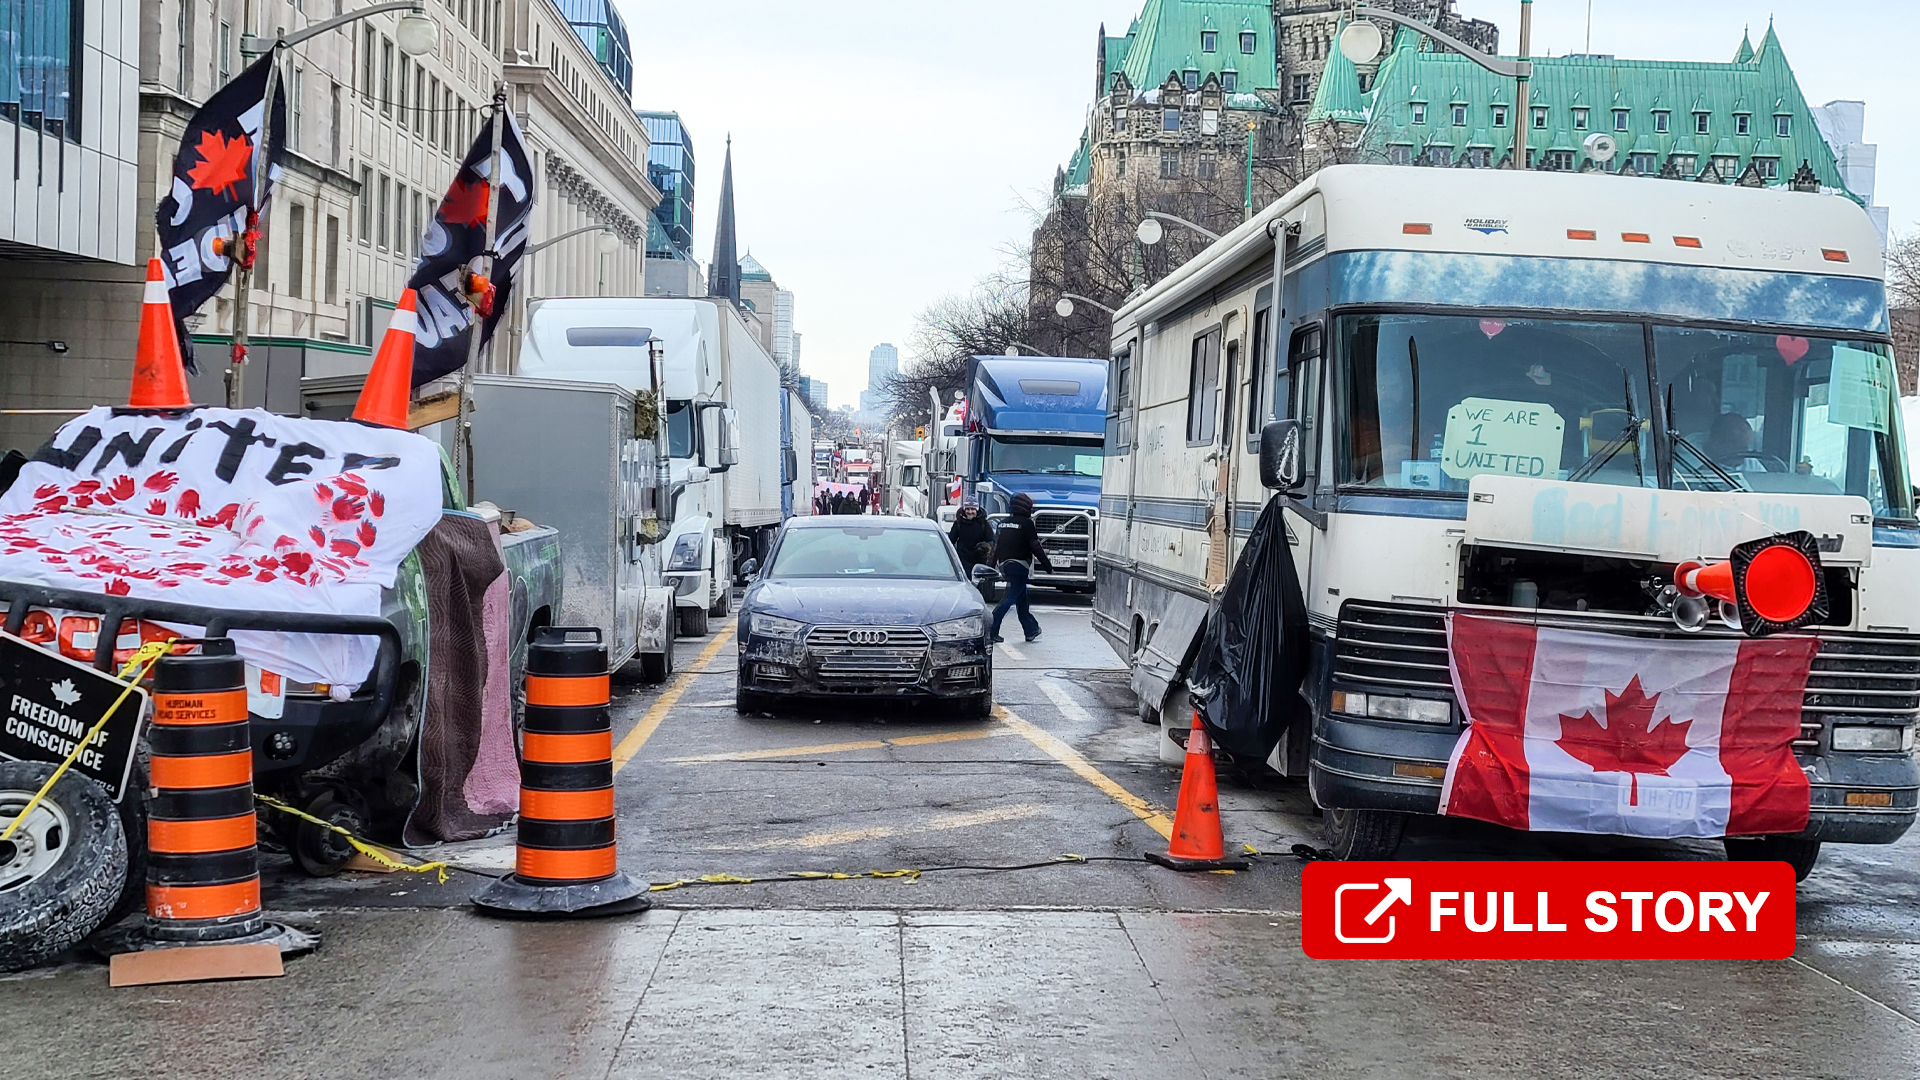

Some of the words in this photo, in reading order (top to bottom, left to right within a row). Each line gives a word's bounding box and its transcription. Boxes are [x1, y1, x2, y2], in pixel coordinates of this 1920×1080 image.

[1465, 407, 1493, 421] WE
[1502, 410, 1540, 426] ARE
[1465, 423, 1487, 446] 1
[1455, 449, 1545, 476] UNITED
[10, 694, 85, 739] FREEDOM
[88, 726, 109, 748] OF
[175, 709, 216, 720] SERVICES
[5, 716, 105, 771] CONSCIENCE
